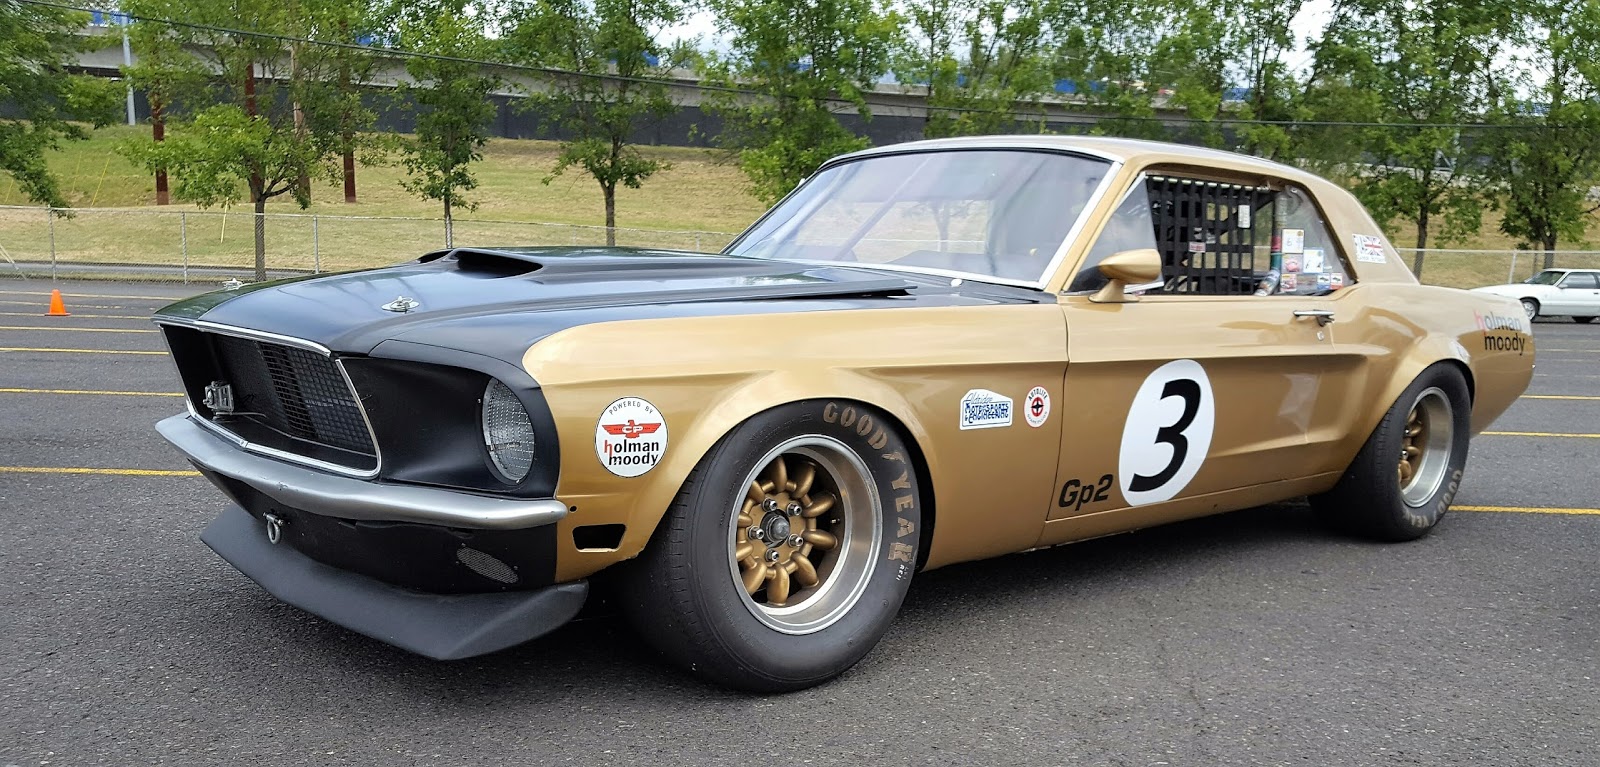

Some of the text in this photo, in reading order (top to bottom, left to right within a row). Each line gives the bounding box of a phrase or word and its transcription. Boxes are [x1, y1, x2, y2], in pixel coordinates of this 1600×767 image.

[1484, 332, 1525, 356] moody
[609, 401, 654, 415] POWERED BY
[1128, 378, 1202, 492] 3
[604, 439, 660, 456] holman
[608, 452, 660, 467] moody
[1058, 473, 1114, 511] Gp2
